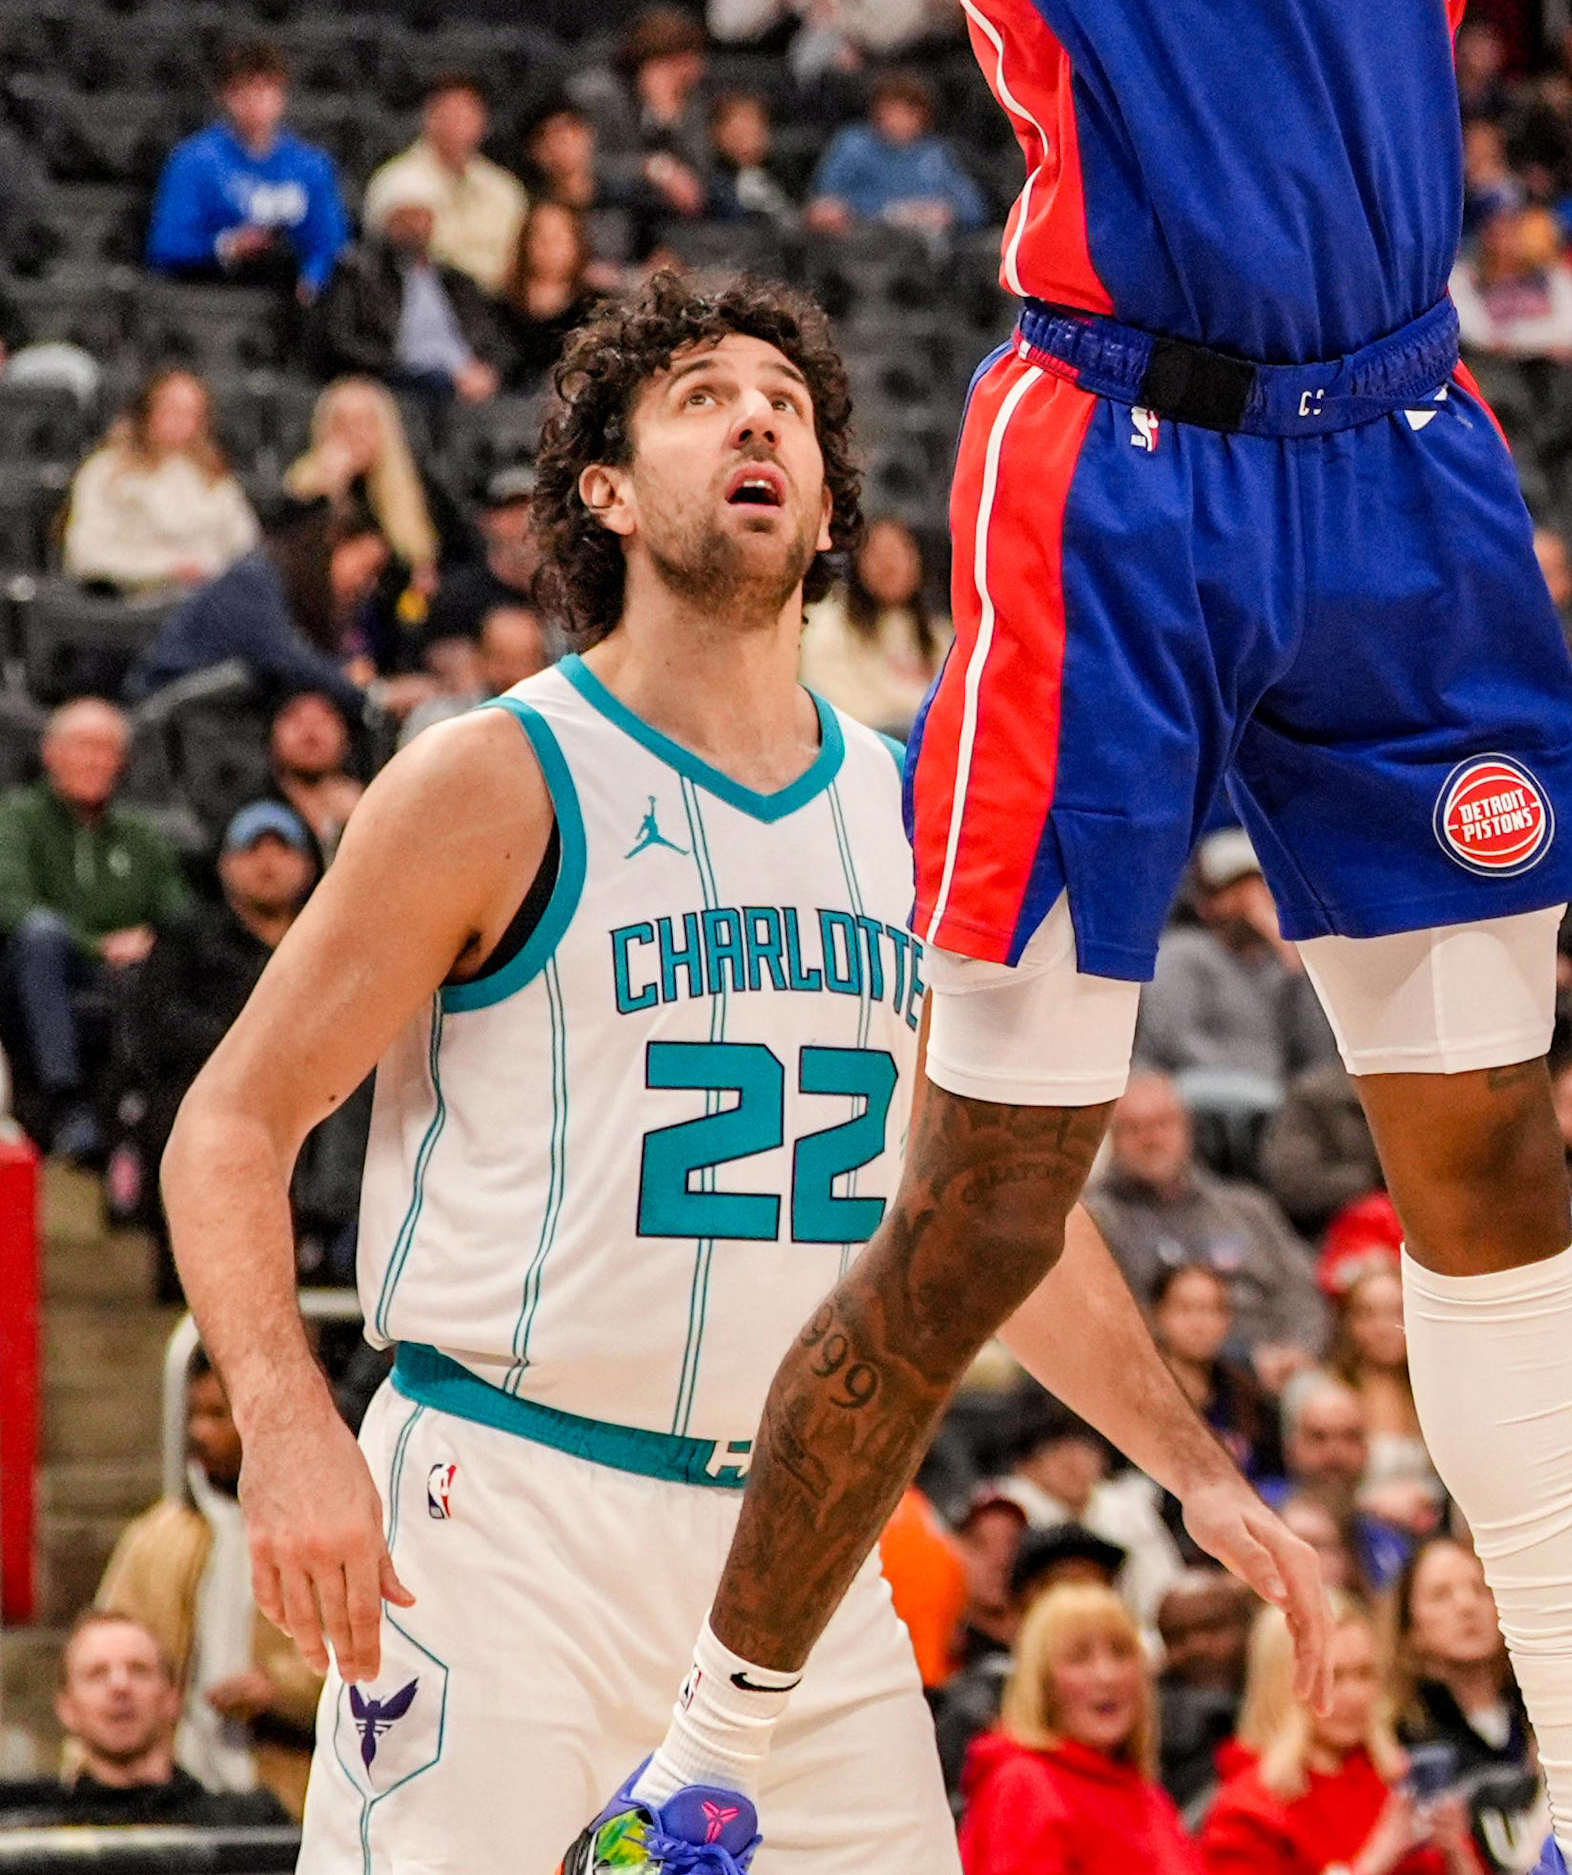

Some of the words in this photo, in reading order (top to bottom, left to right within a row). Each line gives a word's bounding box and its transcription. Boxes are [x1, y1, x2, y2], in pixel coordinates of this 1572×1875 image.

[1458, 788, 1526, 824] DETROIT
[1461, 806, 1534, 843] PISTONS
[609, 906, 925, 1033] CHARLOTTE
[636, 1040, 899, 1244] 22
